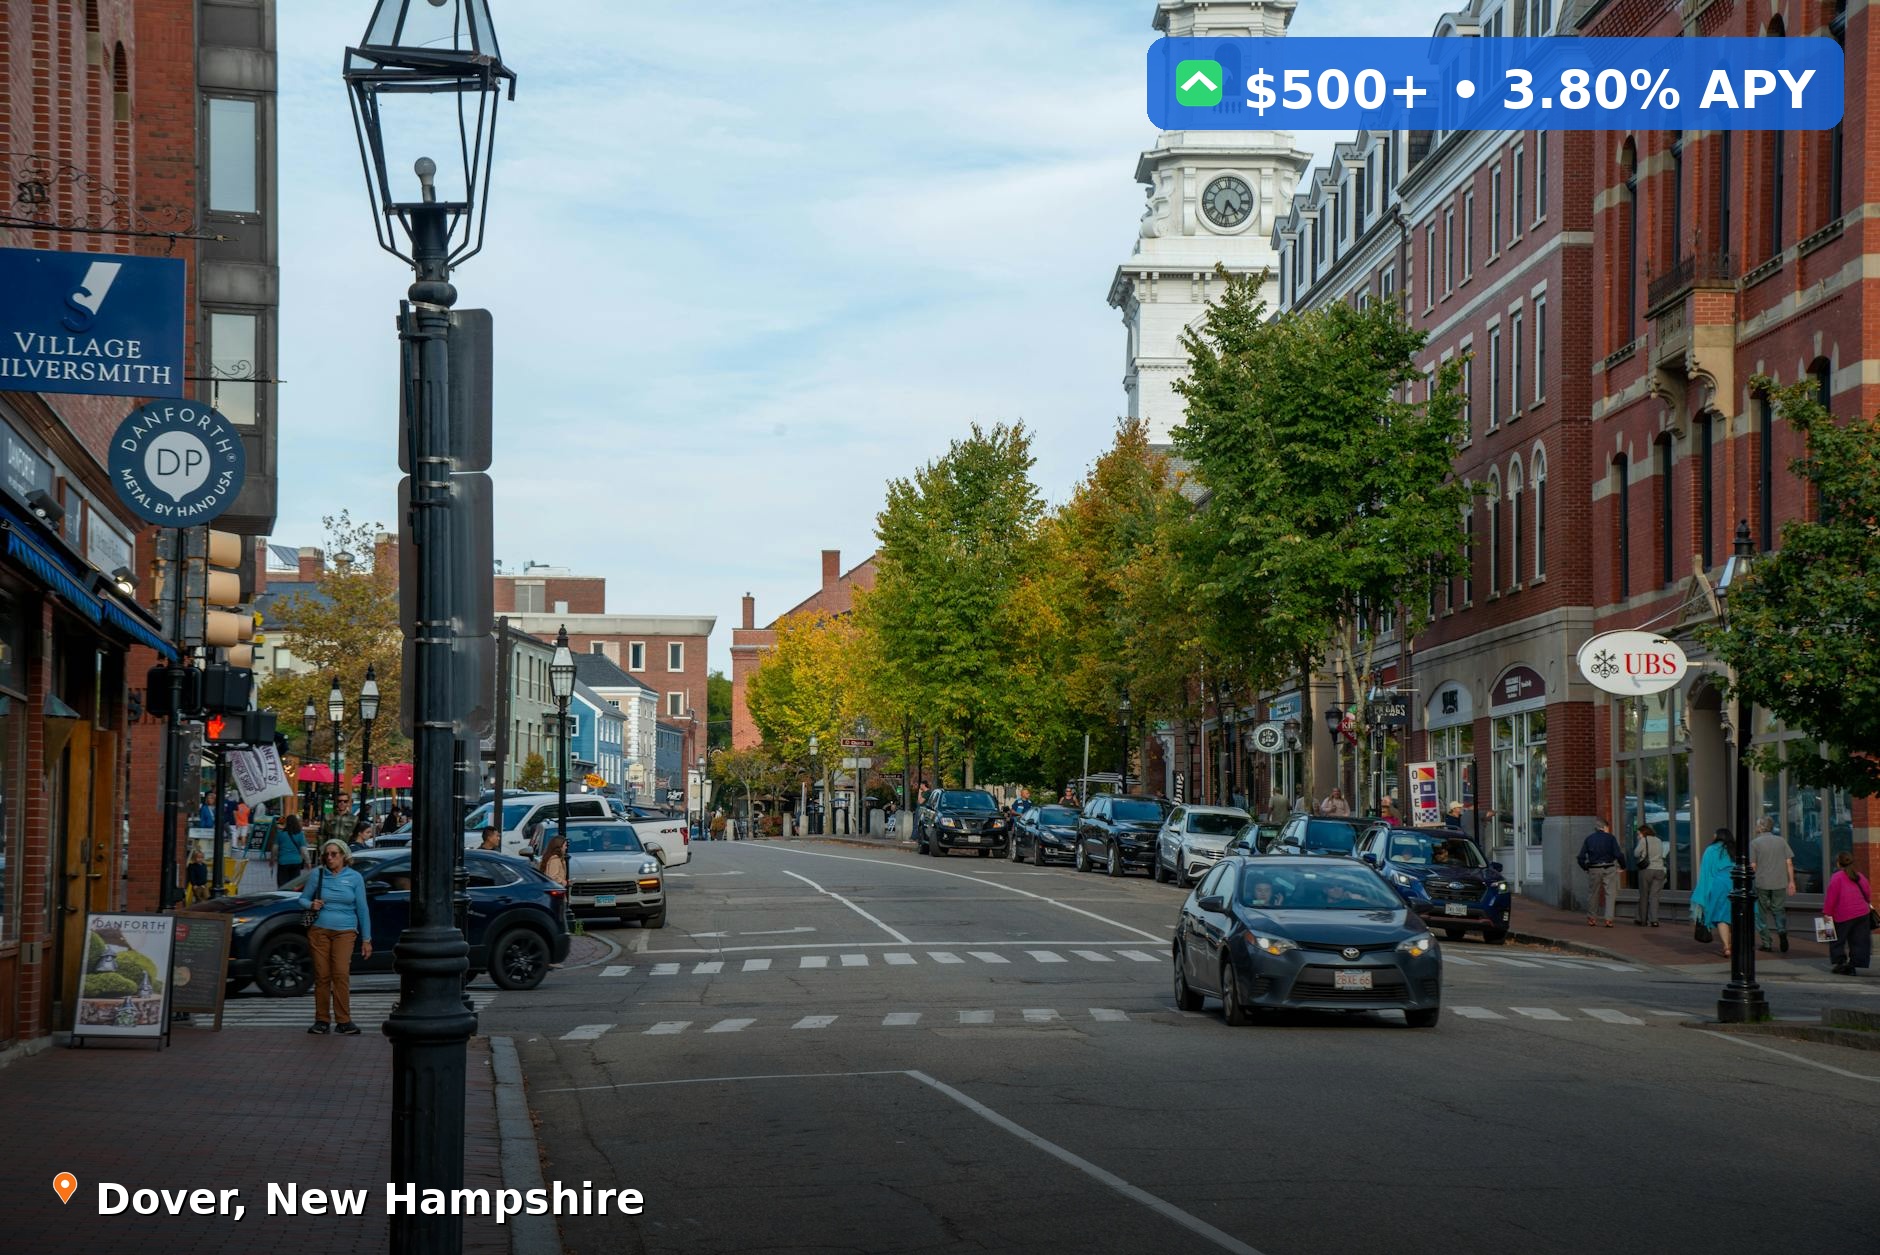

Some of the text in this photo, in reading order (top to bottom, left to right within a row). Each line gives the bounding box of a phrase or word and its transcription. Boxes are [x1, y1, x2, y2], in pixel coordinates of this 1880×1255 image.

[13, 332, 142, 359] VILLAGE
[0, 358, 172, 385] ILVERSMITH
[121, 407, 233, 453] DANFORTH
[157, 448, 203, 477] DP
[121, 468, 234, 517] METAL BY HAND USA
[1623, 653, 1677, 675] UBS
[96, 919, 166, 930] DANFORTH
